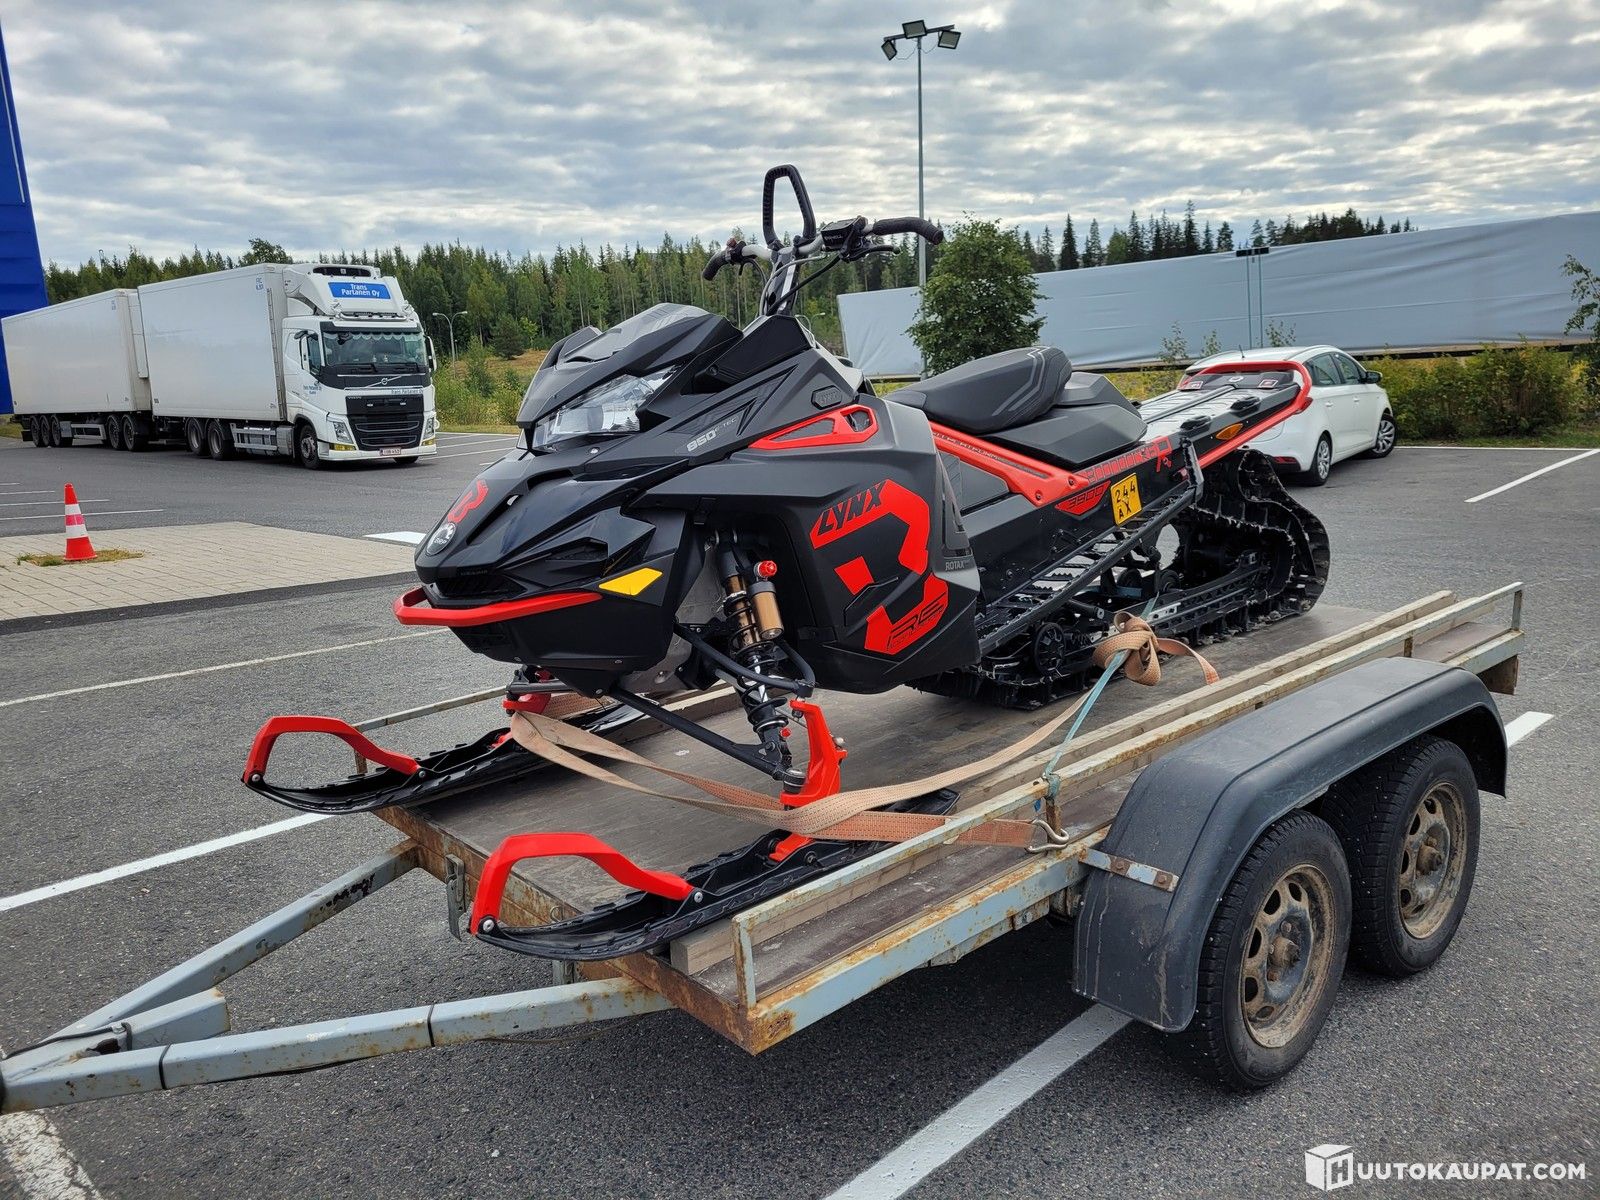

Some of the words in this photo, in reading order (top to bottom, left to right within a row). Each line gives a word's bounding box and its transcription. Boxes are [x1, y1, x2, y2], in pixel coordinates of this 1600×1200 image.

[341, 288, 370, 297] Partanen
[350, 283, 368, 291] Trans
[687, 430, 716, 451] 850
[1115, 481, 1136, 503] 244
[817, 481, 883, 536] LYNX
[944, 559, 966, 571] ROTAX
